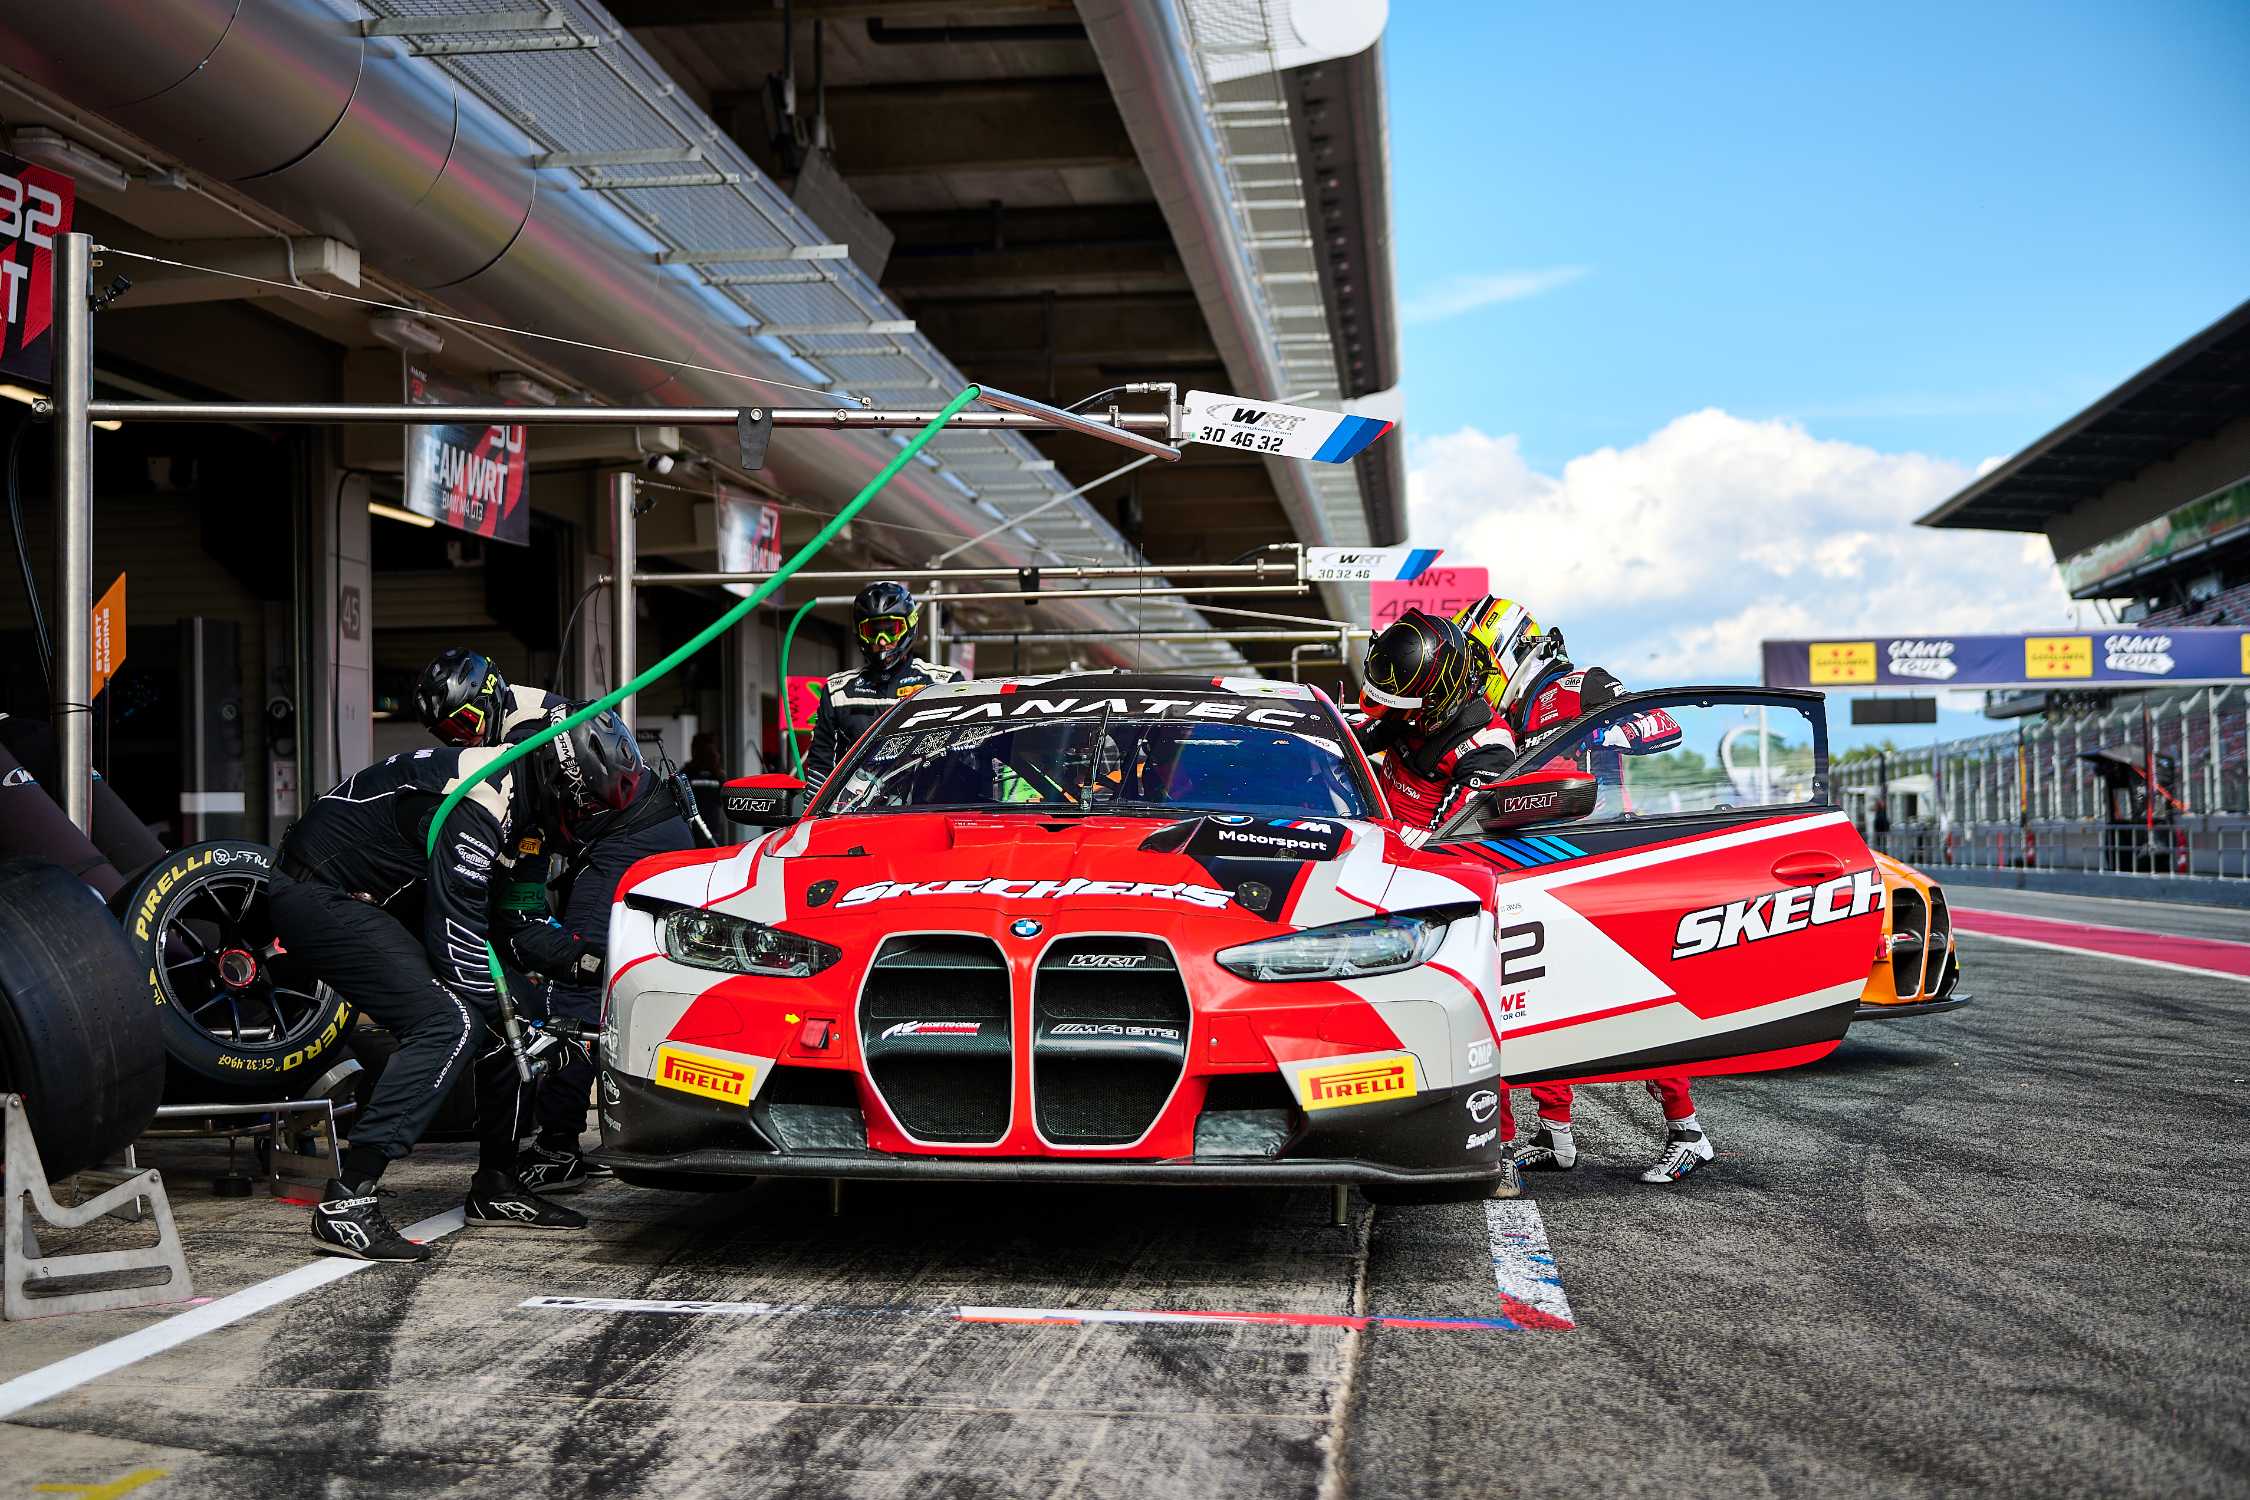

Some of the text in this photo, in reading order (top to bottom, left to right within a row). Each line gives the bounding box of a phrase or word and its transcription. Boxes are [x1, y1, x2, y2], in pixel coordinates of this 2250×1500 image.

[1231, 407, 1306, 431] WRT
[1199, 425, 1284, 452] 30 46 32
[424, 434, 508, 504] TEAM WRT
[1338, 554, 1387, 565] WRT
[1318, 569, 1370, 579] 30 32 46
[343, 595, 360, 631] 45
[1888, 640, 1955, 658] GRAND
[2104, 635, 2172, 652] GRAND
[899, 698, 1306, 729] FANATEC
[727, 797, 776, 812] WRT
[1504, 791, 1558, 813] WRT
[1218, 830, 1327, 851] Motorsport
[135, 850, 212, 942] PIRELLI
[835, 877, 1236, 910] SKECHERS
[1671, 868, 1886, 961] SKECH
[1067, 954, 1146, 968] WRT
[283, 1001, 351, 1072] ZERO
[1125, 1026, 1179, 1040] GT3
[1468, 1044, 1493, 1068] OMP
[664, 1055, 745, 1096] PIRELLI
[1310, 1066, 1405, 1101] PIRELLI
